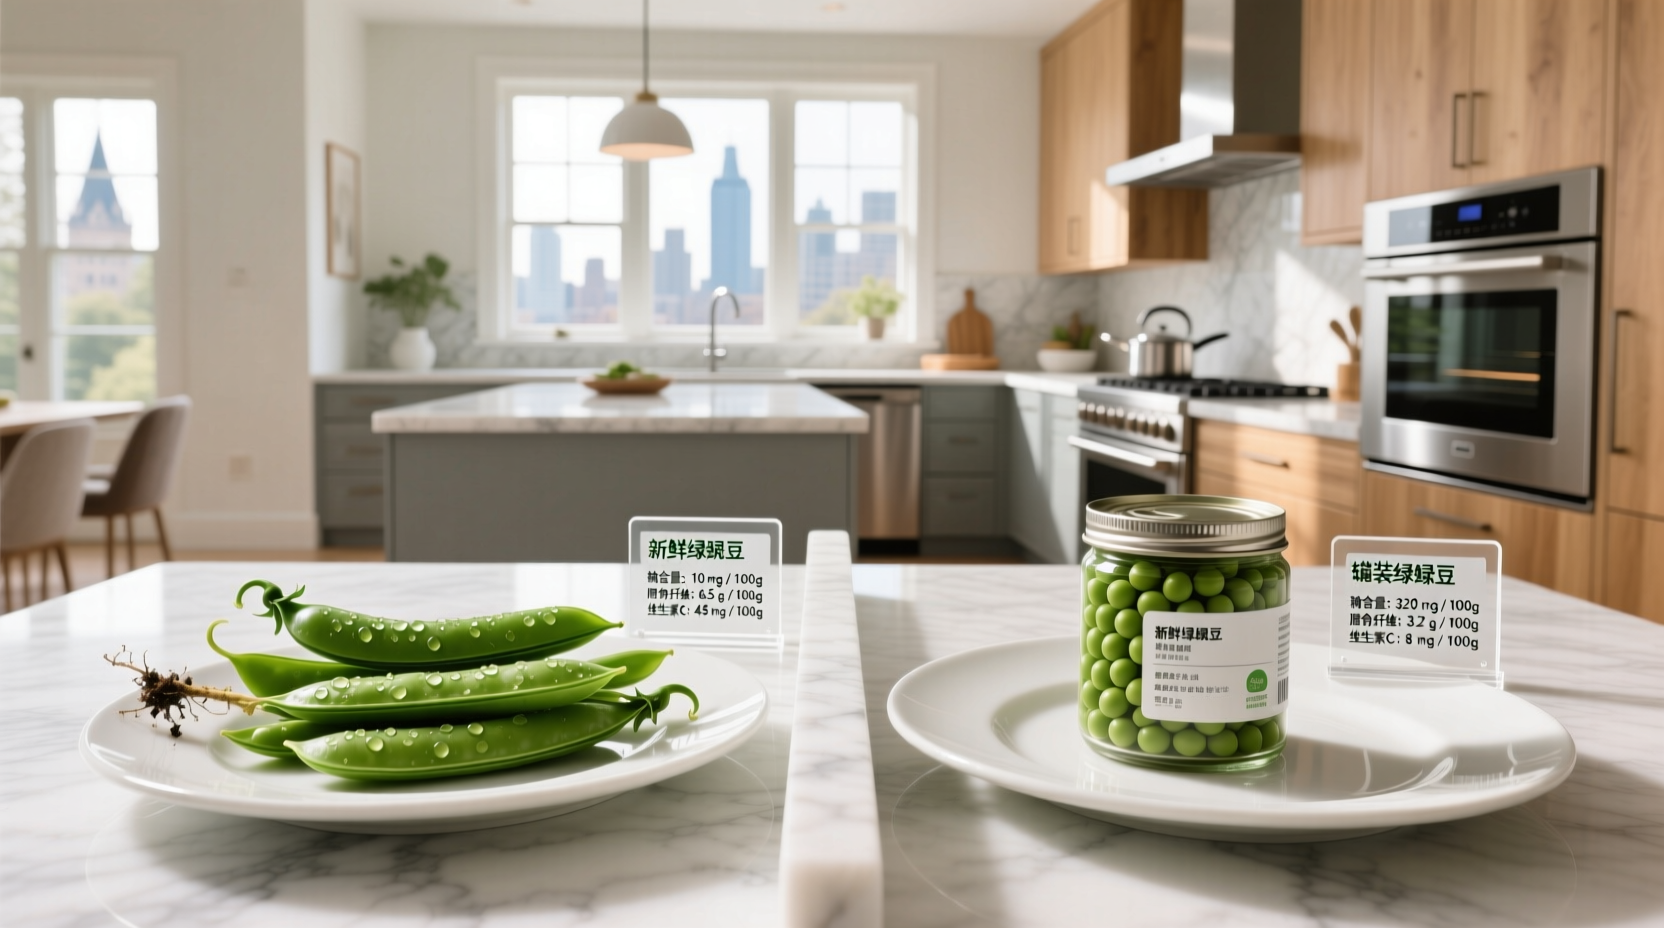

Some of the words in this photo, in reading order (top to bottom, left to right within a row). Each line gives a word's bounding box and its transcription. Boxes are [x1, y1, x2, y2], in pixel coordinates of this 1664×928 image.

[692, 573, 705, 583] 10
[708, 576, 723, 588] mg
[735, 574, 762, 588] 100g
[737, 590, 762, 604] 100g
[694, 604, 708, 616] 45
[711, 608, 726, 619] mg
[737, 606, 763, 620] 100g
[1396, 598, 1418, 610] 320
[1450, 600, 1479, 615] 100g
[1429, 620, 1436, 631] g
[1449, 617, 1478, 632] 100g
[1406, 633, 1412, 644] 8
[1418, 637, 1434, 649] mg
[1448, 635, 1478, 651] 100g
